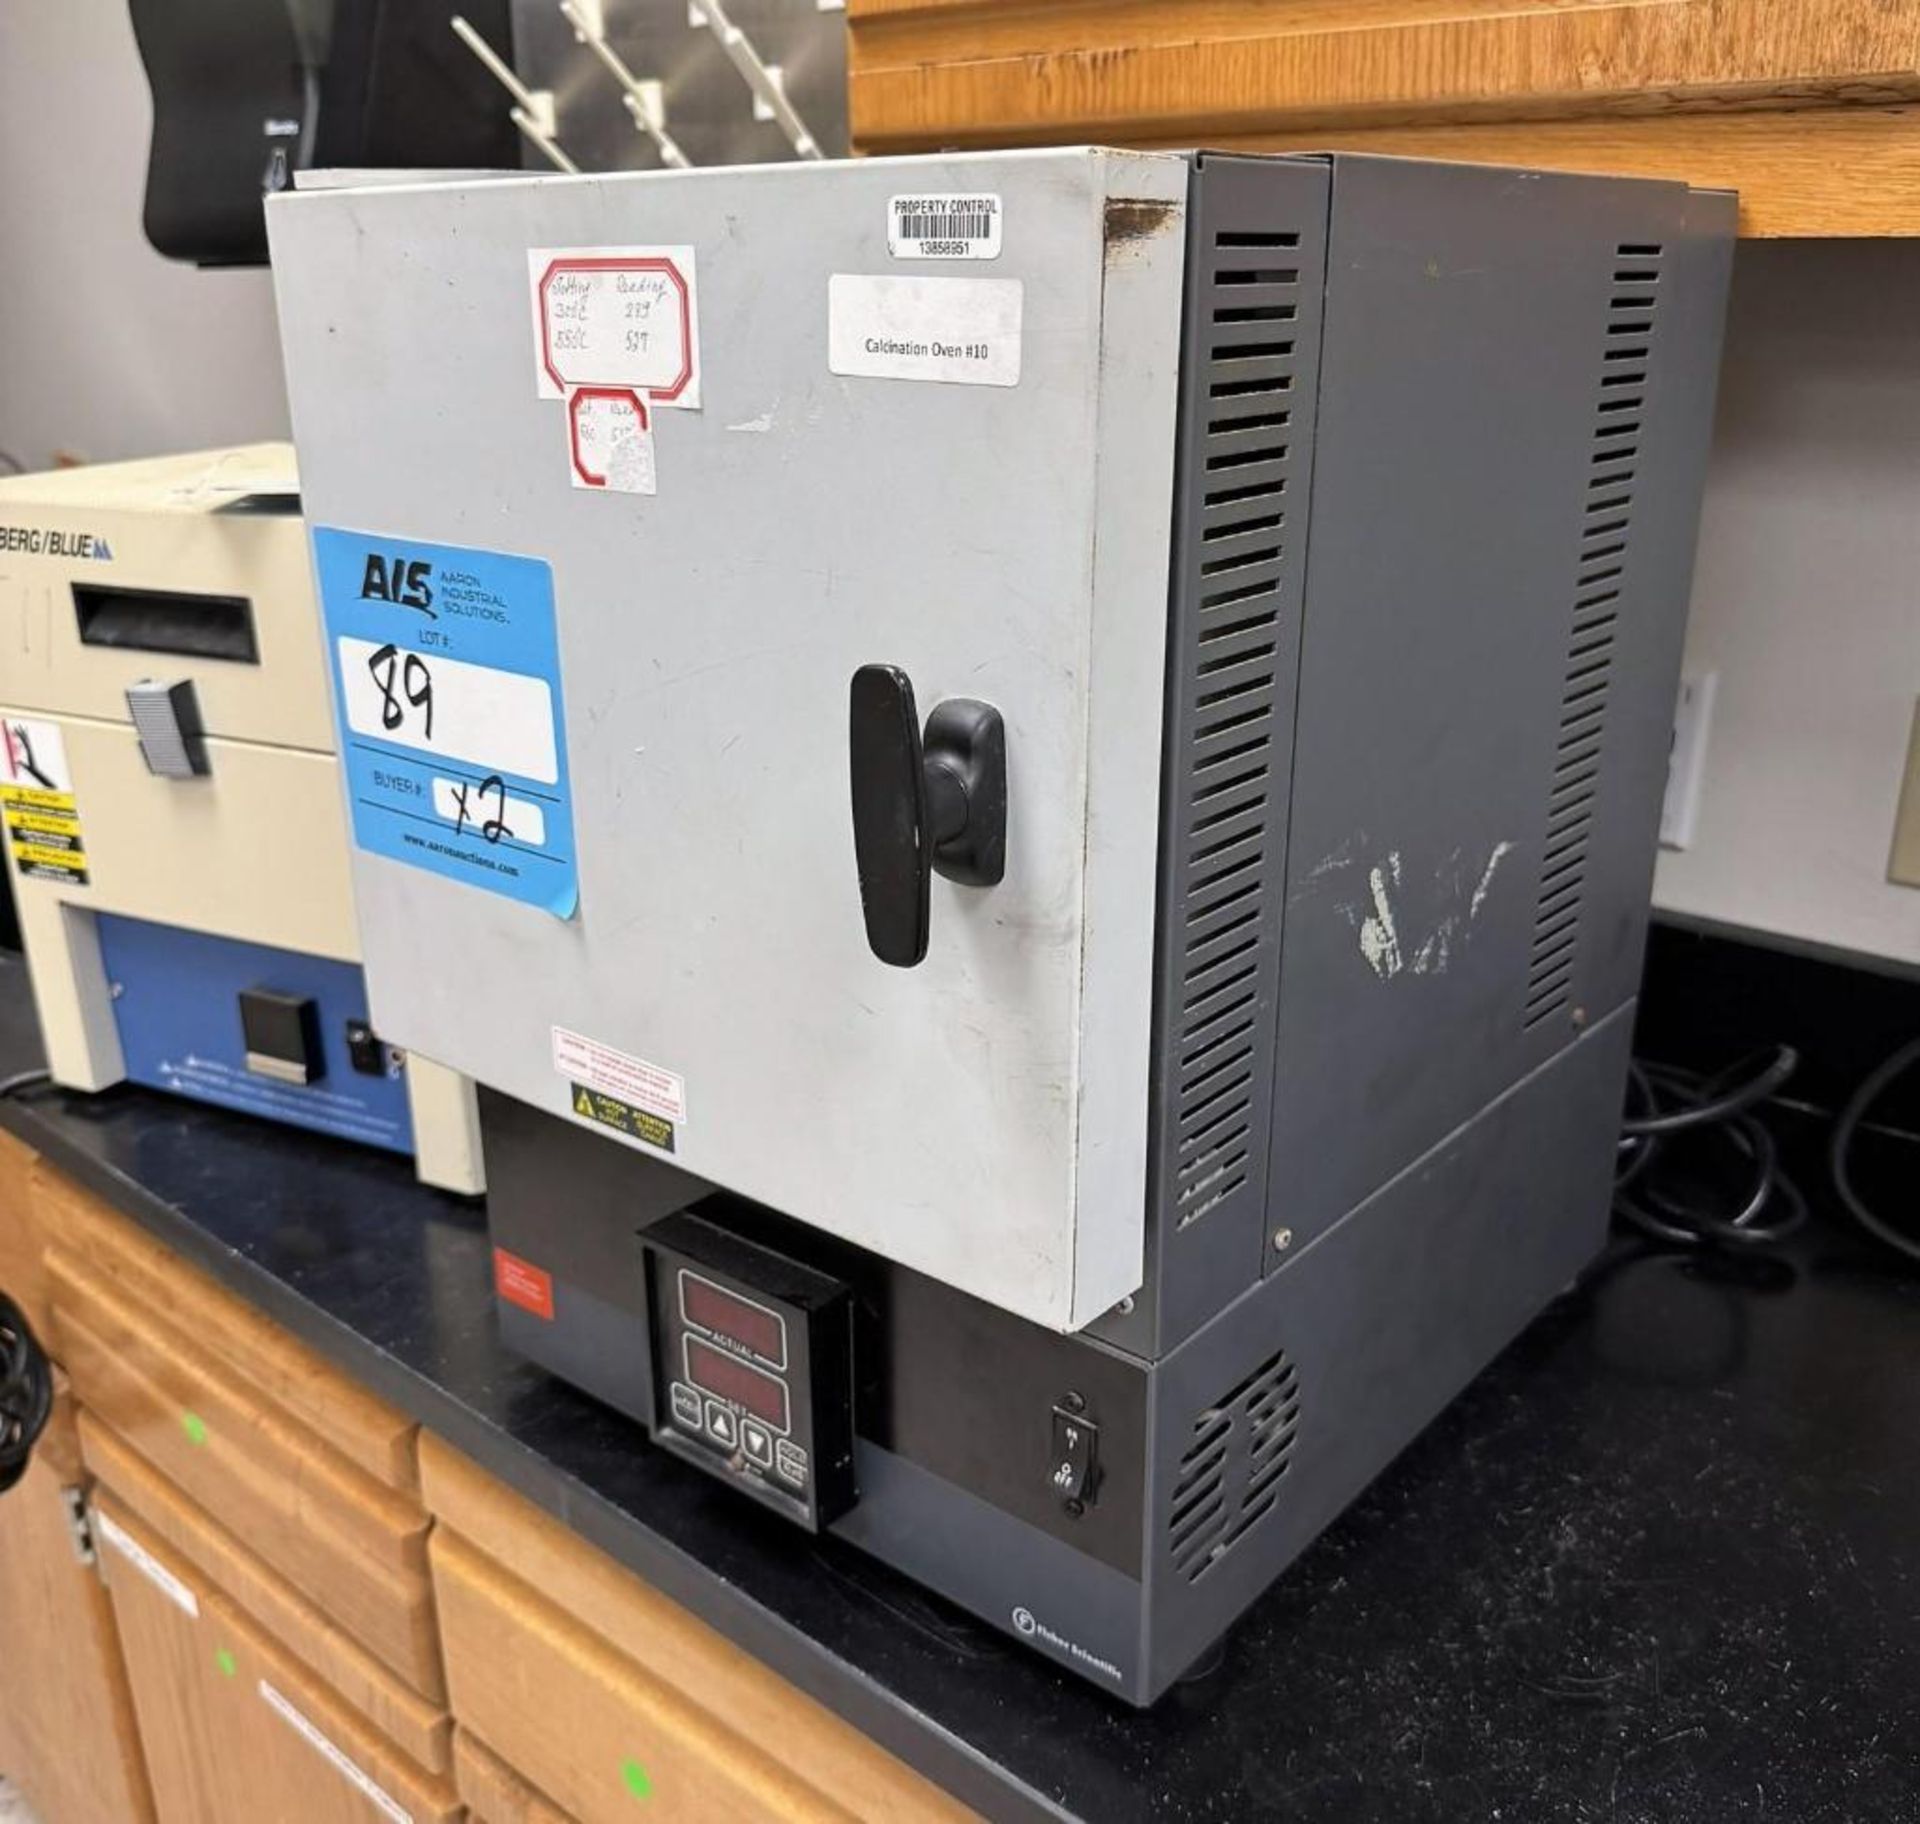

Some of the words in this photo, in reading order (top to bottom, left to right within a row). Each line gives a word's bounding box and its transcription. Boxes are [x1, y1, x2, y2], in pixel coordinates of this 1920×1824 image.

[895, 199, 946, 215] PROPERTY
[949, 199, 998, 214] CONTROL
[865, 338, 928, 357] Calcination
[931, 341, 962, 358] Oven
[965, 343, 988, 360] #10
[361, 553, 435, 611] AIS
[441, 570, 481, 589] AARON
[441, 586, 508, 609] INDUSTRIAL
[419, 629, 440, 646] LOT
[368, 643, 433, 742] 89
[374, 769, 414, 795] BUYER
[712, 1332, 753, 1360] ACTUAL
